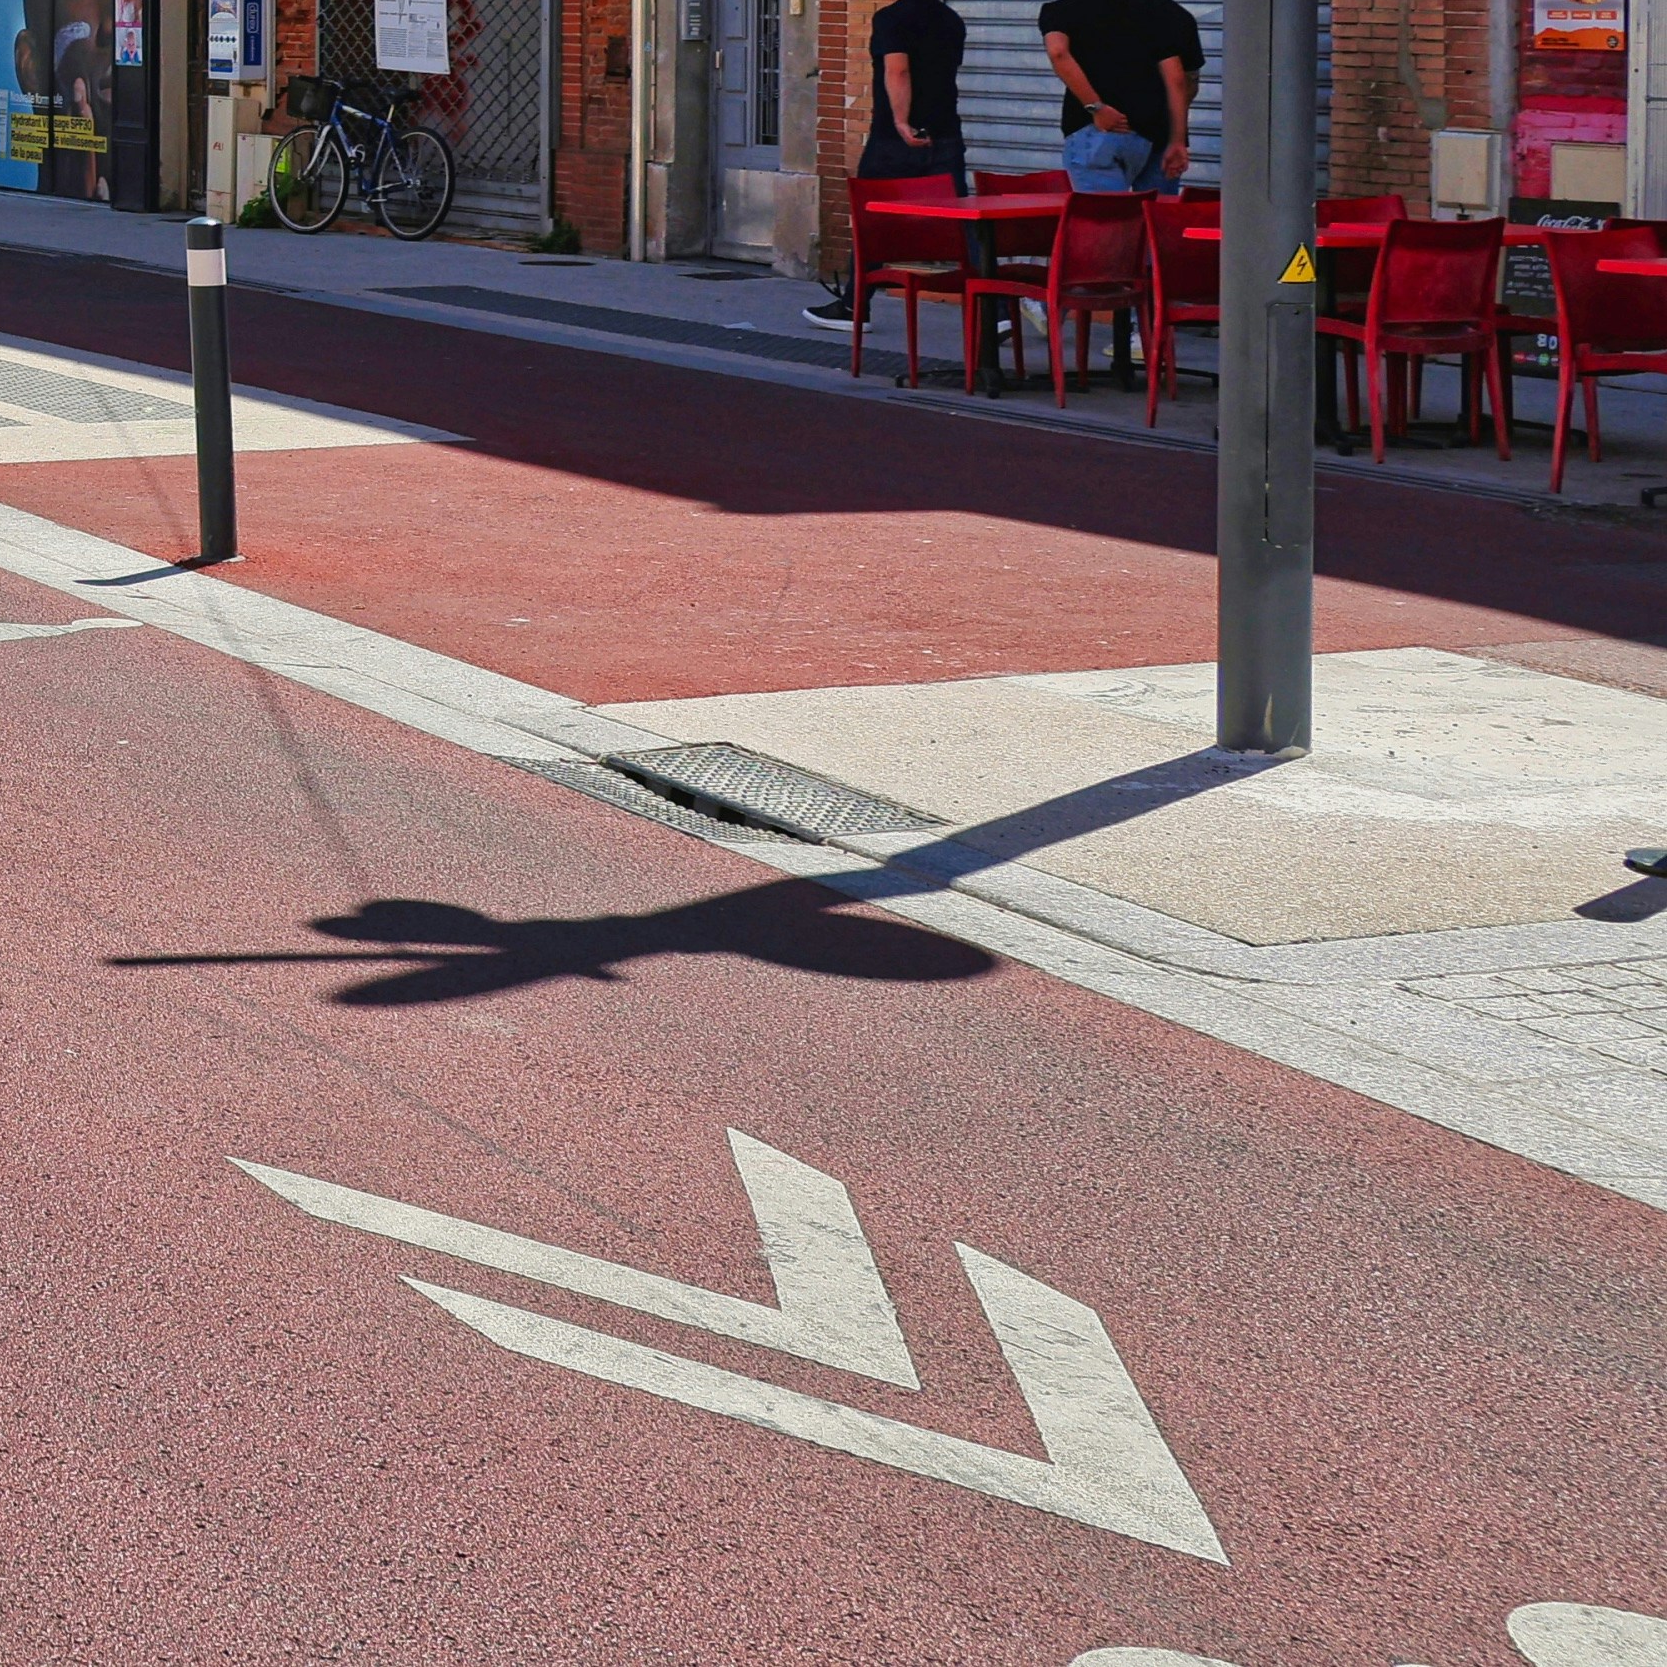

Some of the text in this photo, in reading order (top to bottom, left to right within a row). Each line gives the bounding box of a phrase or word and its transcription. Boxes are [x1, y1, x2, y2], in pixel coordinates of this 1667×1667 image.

[249, 4, 258, 33] durex
[11, 114, 40, 128] Hydratant
[70, 117, 92, 132] SPF30
